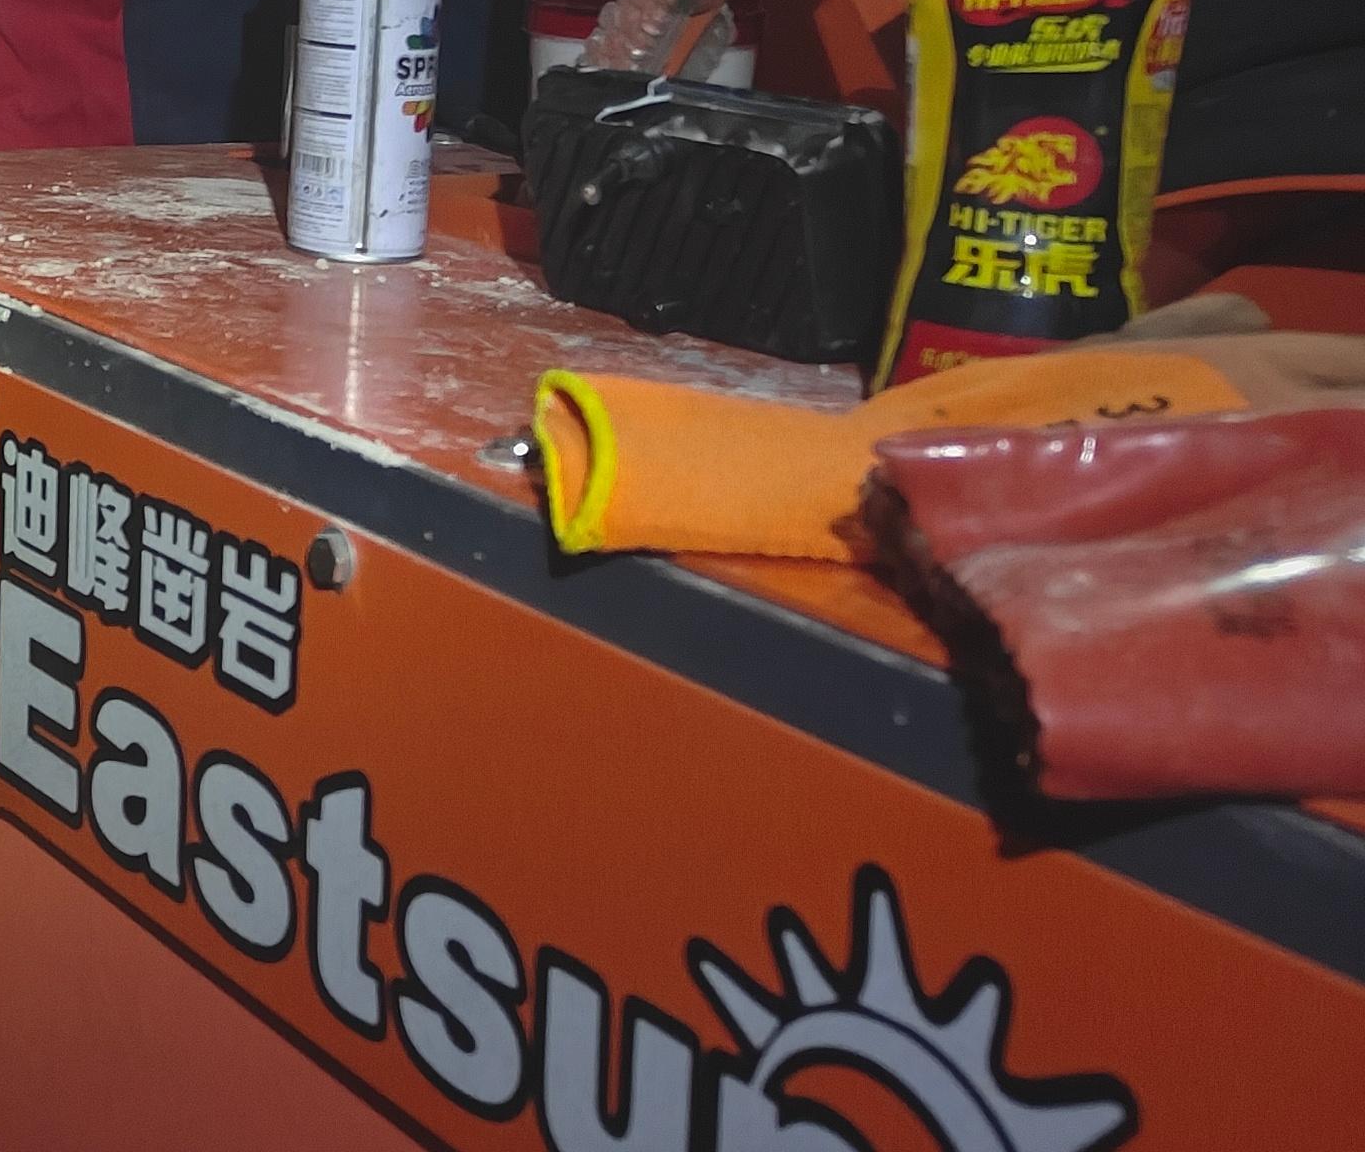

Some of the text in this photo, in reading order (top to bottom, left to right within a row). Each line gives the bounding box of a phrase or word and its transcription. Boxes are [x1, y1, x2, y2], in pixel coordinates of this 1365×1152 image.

[949, 202, 1108, 243] HI-TIGER
[941, 235, 1100, 298] 乐虎
[0, 438, 299, 700] 迪峰凿岩
